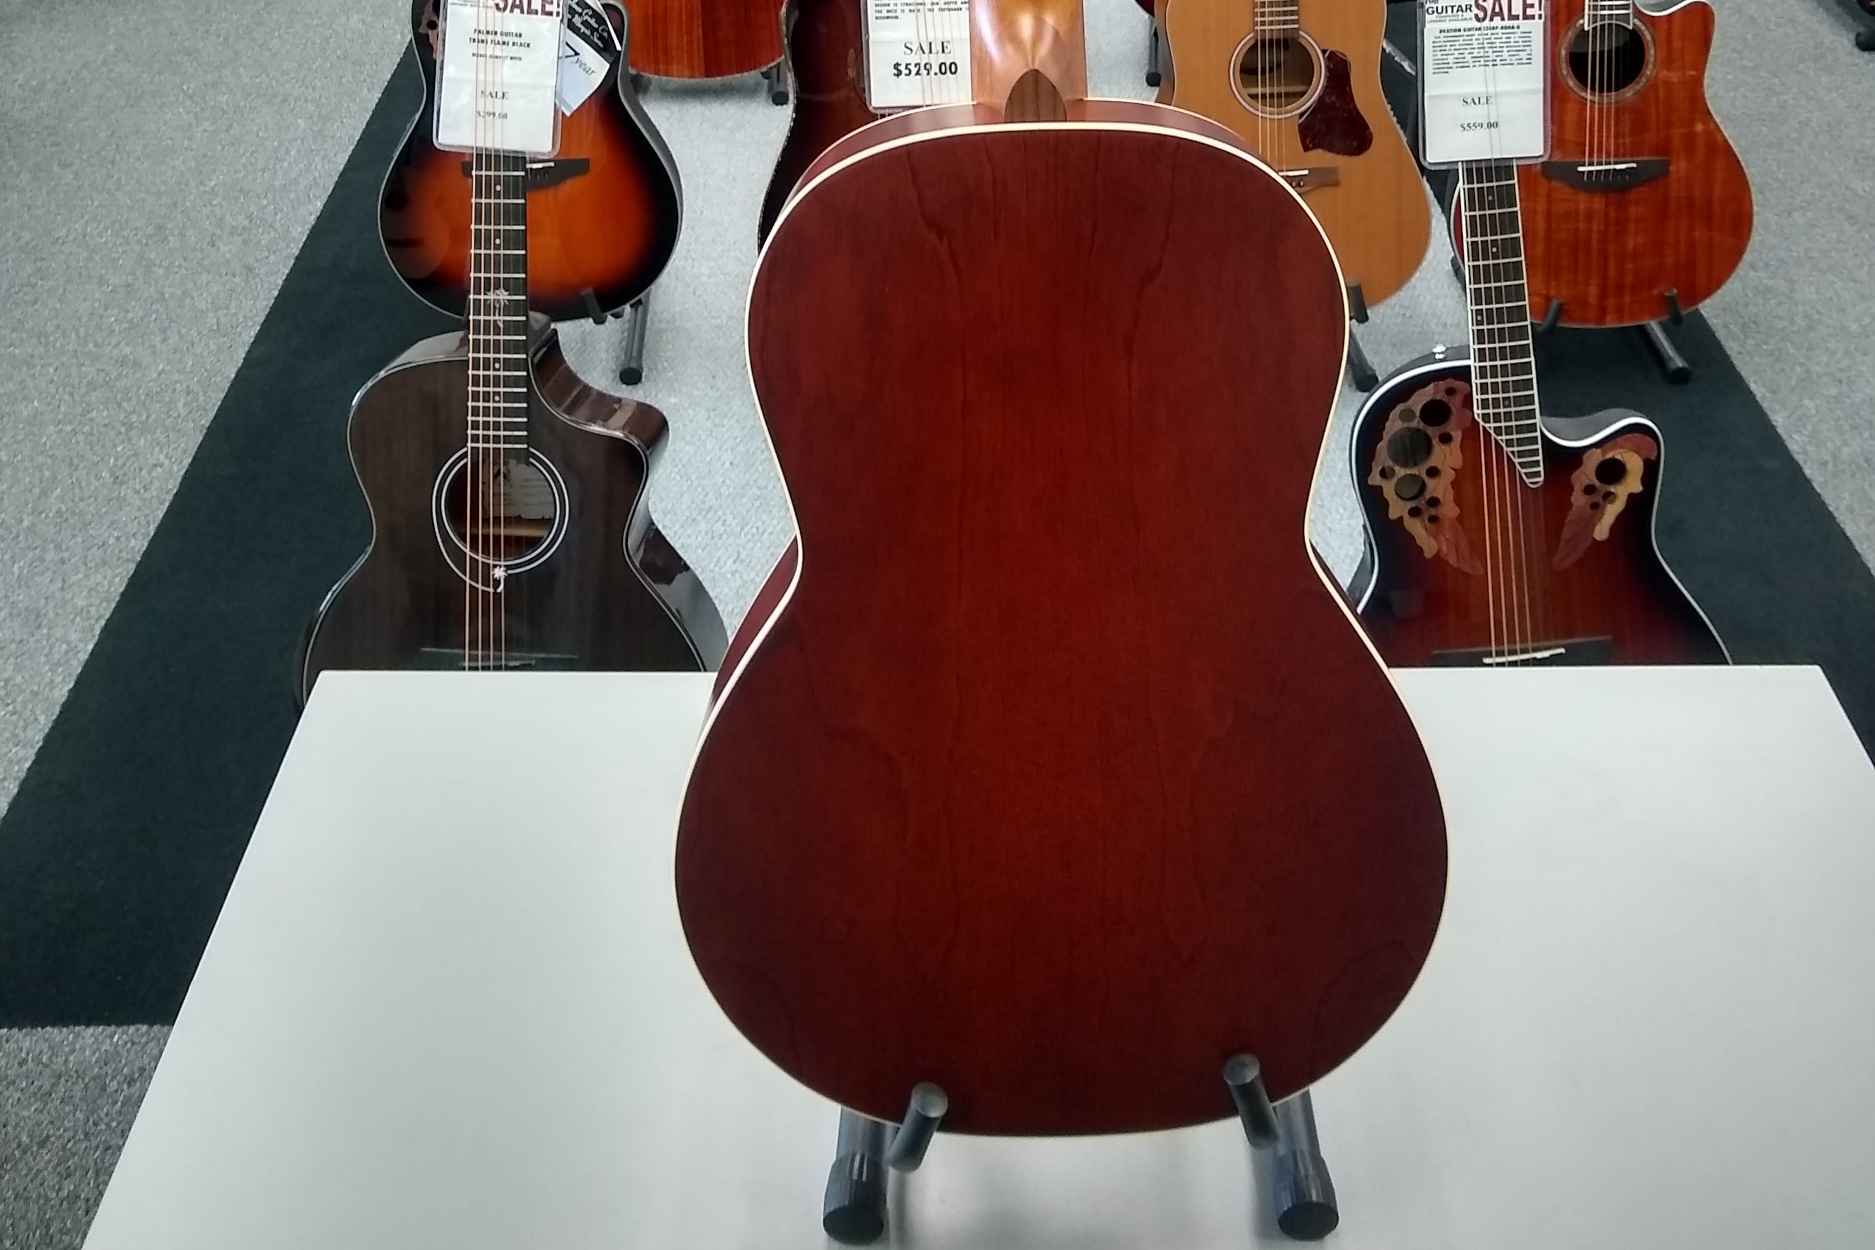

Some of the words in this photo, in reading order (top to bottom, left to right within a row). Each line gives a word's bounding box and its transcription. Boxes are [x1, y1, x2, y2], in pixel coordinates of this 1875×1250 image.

[1426, 3, 1473, 15] GUITAR
[903, 40, 952, 56] SALE
[571, 56, 597, 77] year
[893, 61, 958, 78] $529.00
[480, 90, 509, 100] SALE
[1462, 96, 1493, 106] SALE
[1460, 121, 1499, 132] $559.00
